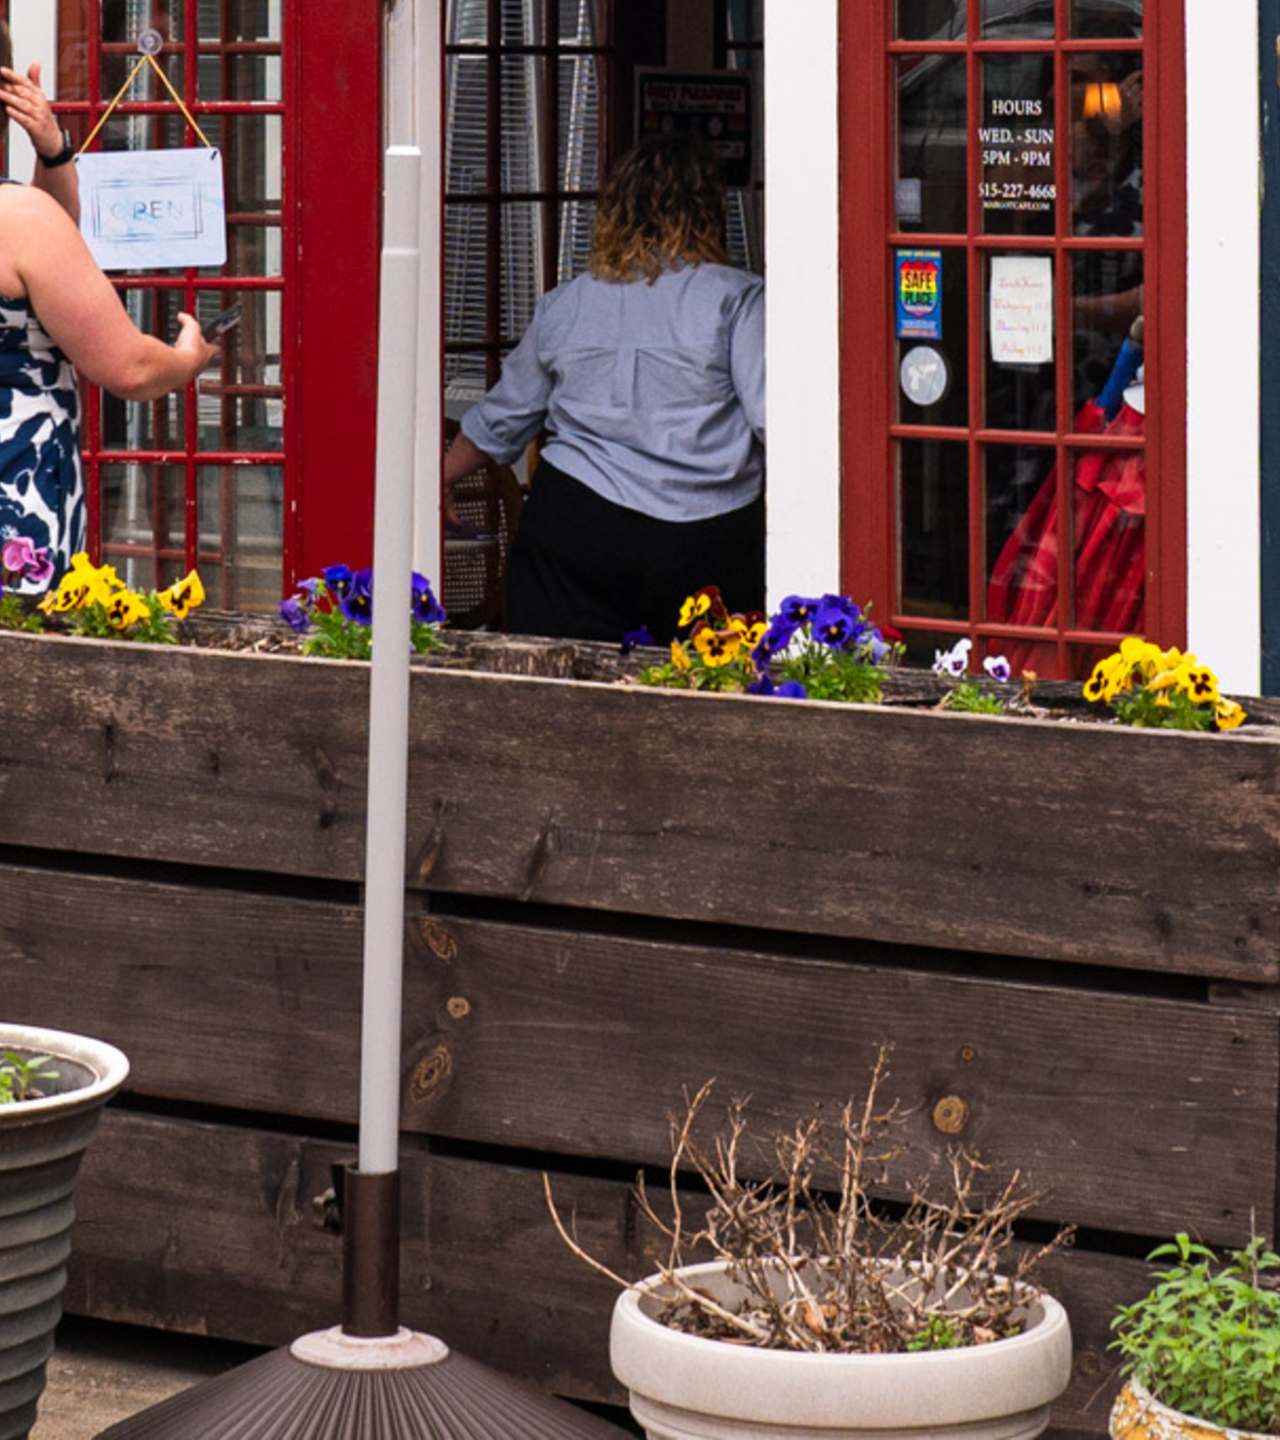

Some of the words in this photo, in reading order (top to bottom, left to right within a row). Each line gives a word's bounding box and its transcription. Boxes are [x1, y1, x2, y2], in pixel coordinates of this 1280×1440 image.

[991, 99, 1042, 116] HOURS
[977, 127, 1014, 144] WED.
[1024, 127, 1054, 144] SUN
[982, 150, 1011, 165] 5PM
[1020, 150, 1051, 167] 9PM
[904, 269, 933, 290] SAFE
